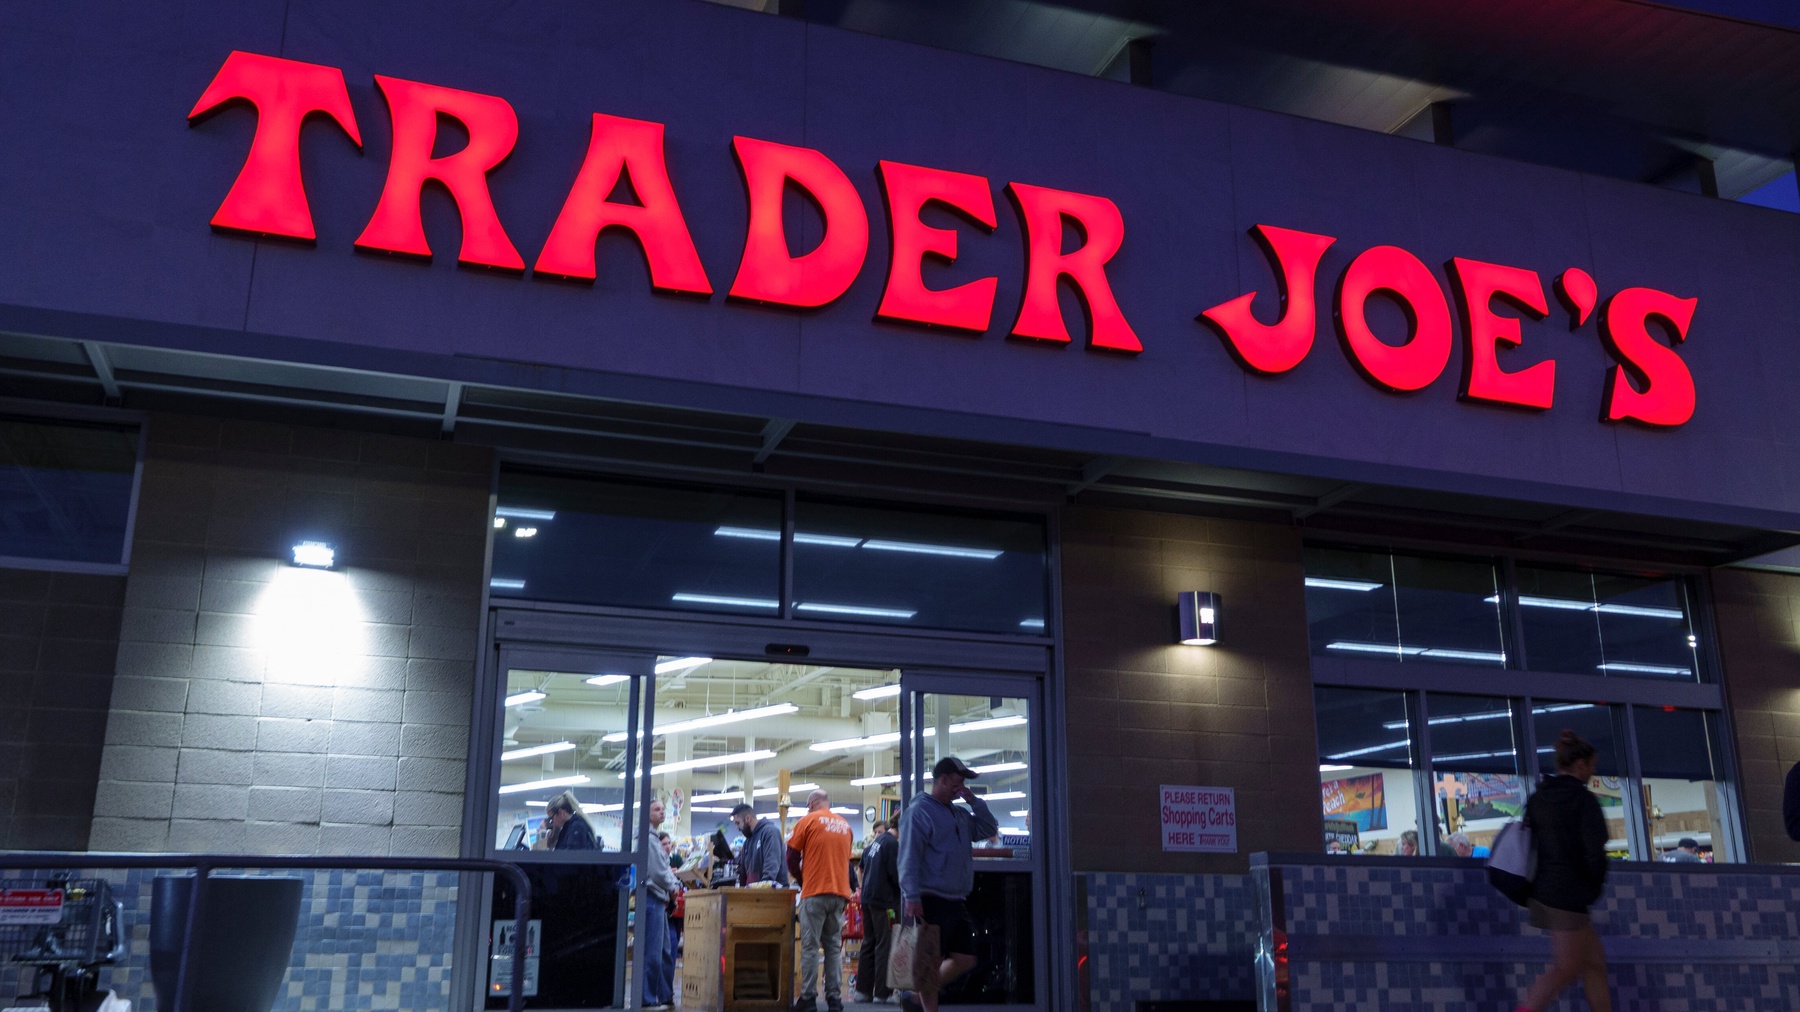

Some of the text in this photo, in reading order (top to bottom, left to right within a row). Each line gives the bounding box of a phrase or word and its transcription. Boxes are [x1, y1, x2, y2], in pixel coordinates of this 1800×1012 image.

[188, 50, 1697, 427] TRADER JOE'S
[1164, 791, 1230, 805] PLEASE RETURN
[1162, 805, 1235, 829] Shopping Carts
[1168, 832, 1195, 845] HERE
